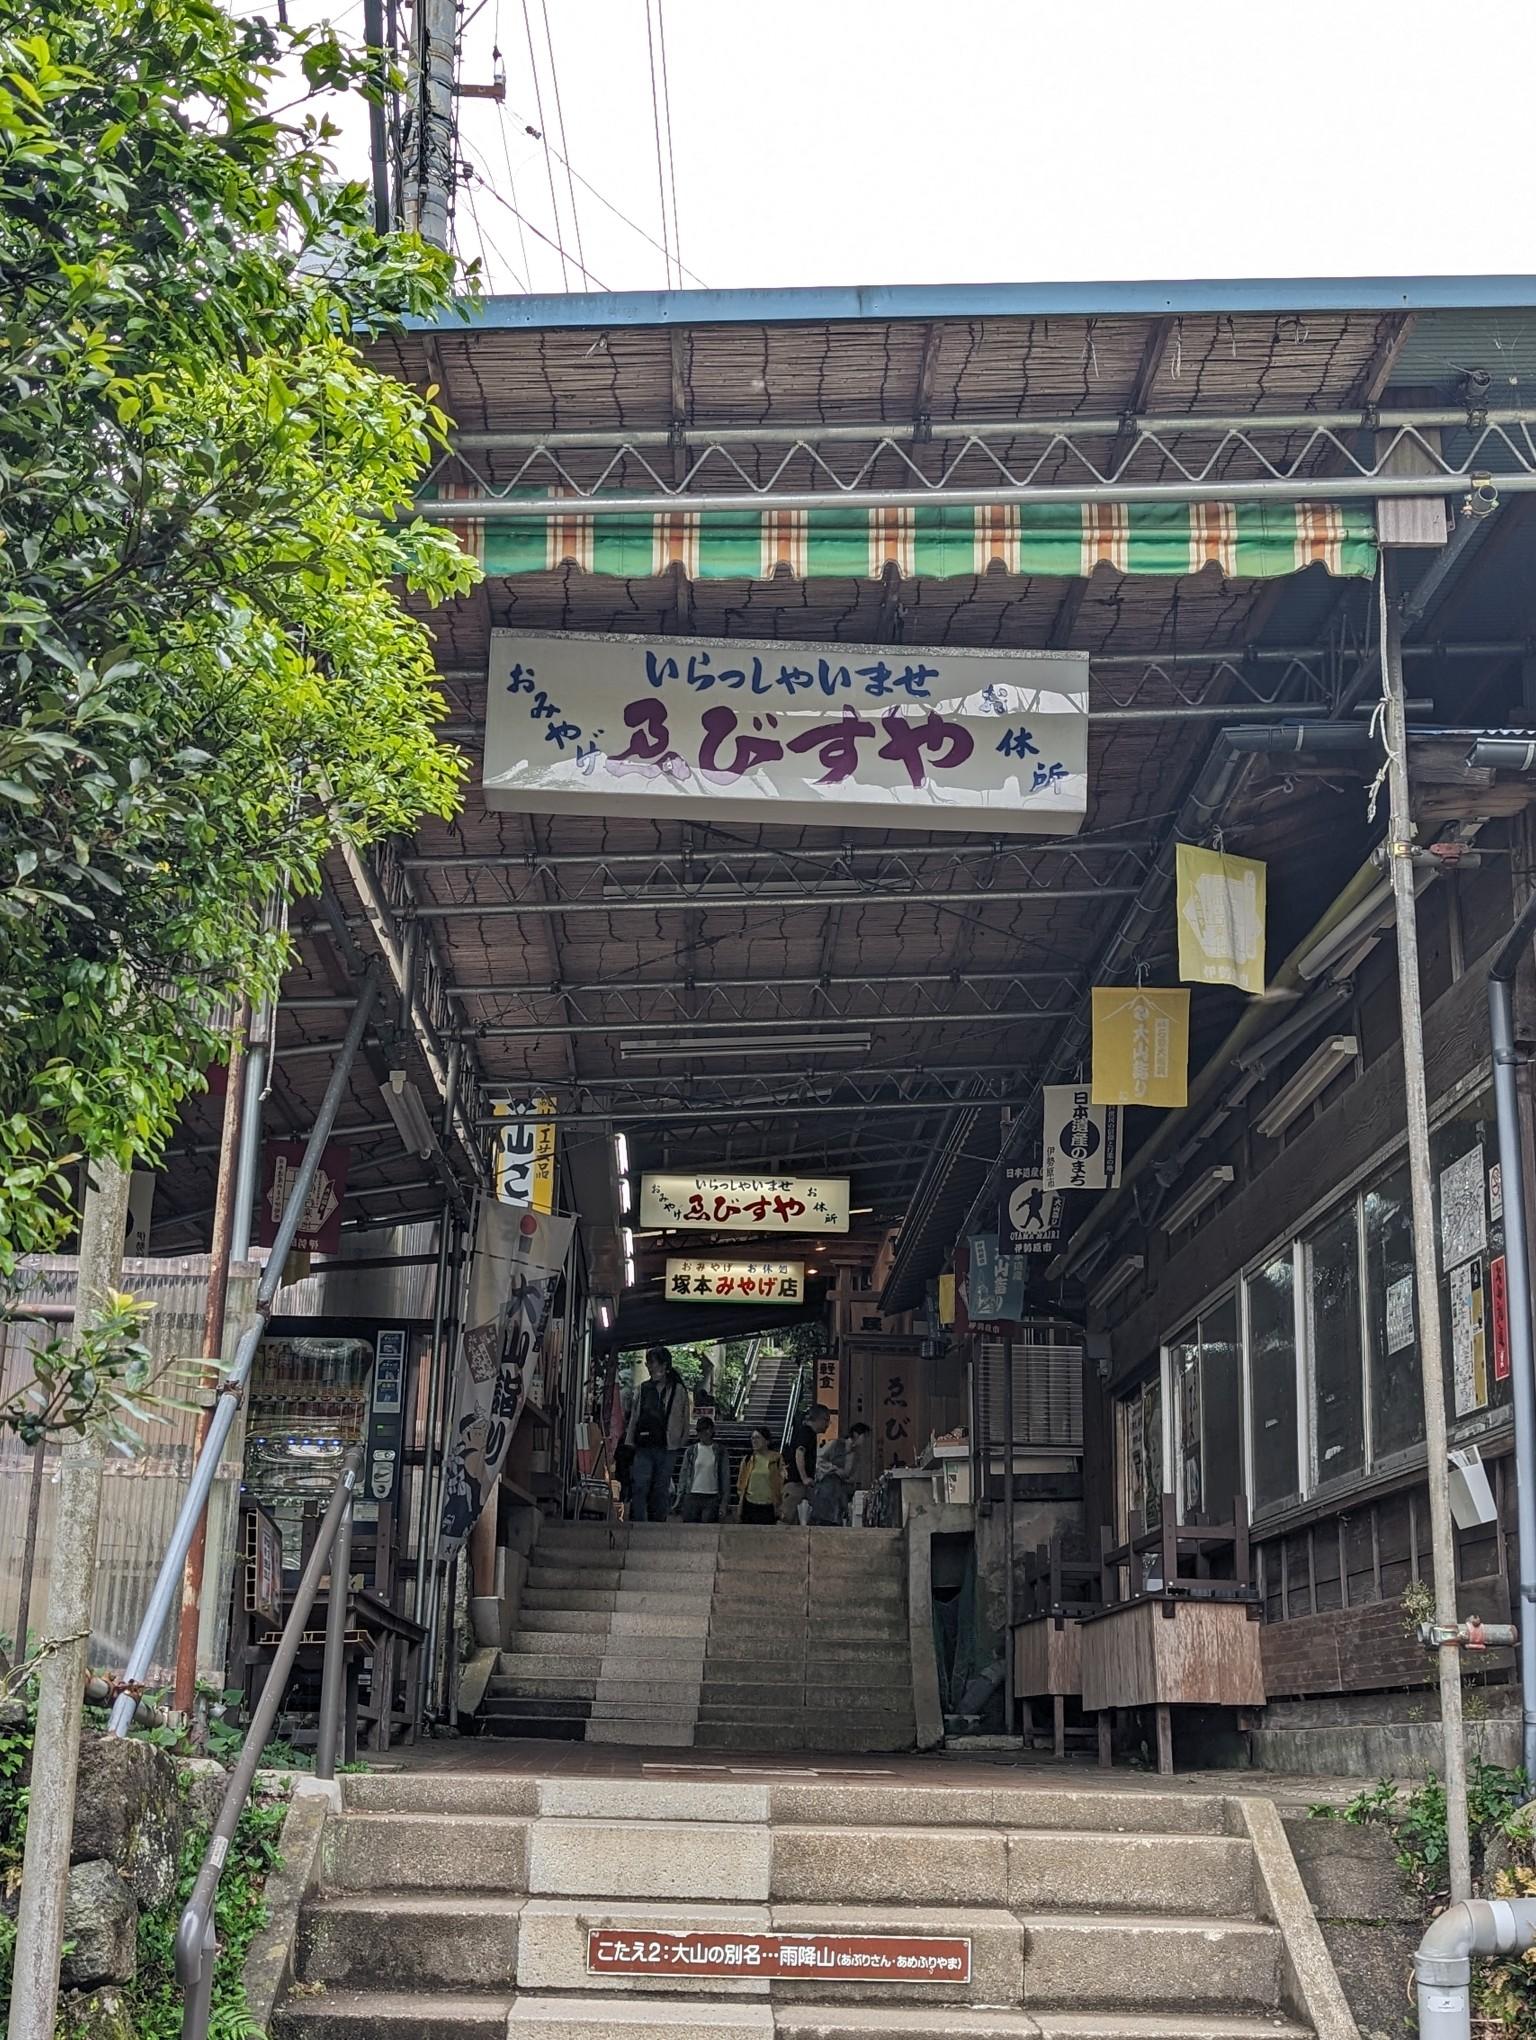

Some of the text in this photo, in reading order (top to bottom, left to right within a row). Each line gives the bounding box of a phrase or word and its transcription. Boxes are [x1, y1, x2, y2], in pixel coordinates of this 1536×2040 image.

[506, 663, 605, 776] おみやげ
[1070, 1092, 1089, 1186] 日本遺産のまち
[683, 1194, 806, 1223] ゑびすや
[807, 1187, 838, 1225] お休所
[671, 1274, 798, 1297] 塚本みやげ店
[818, 1362, 836, 1389] 軽食
